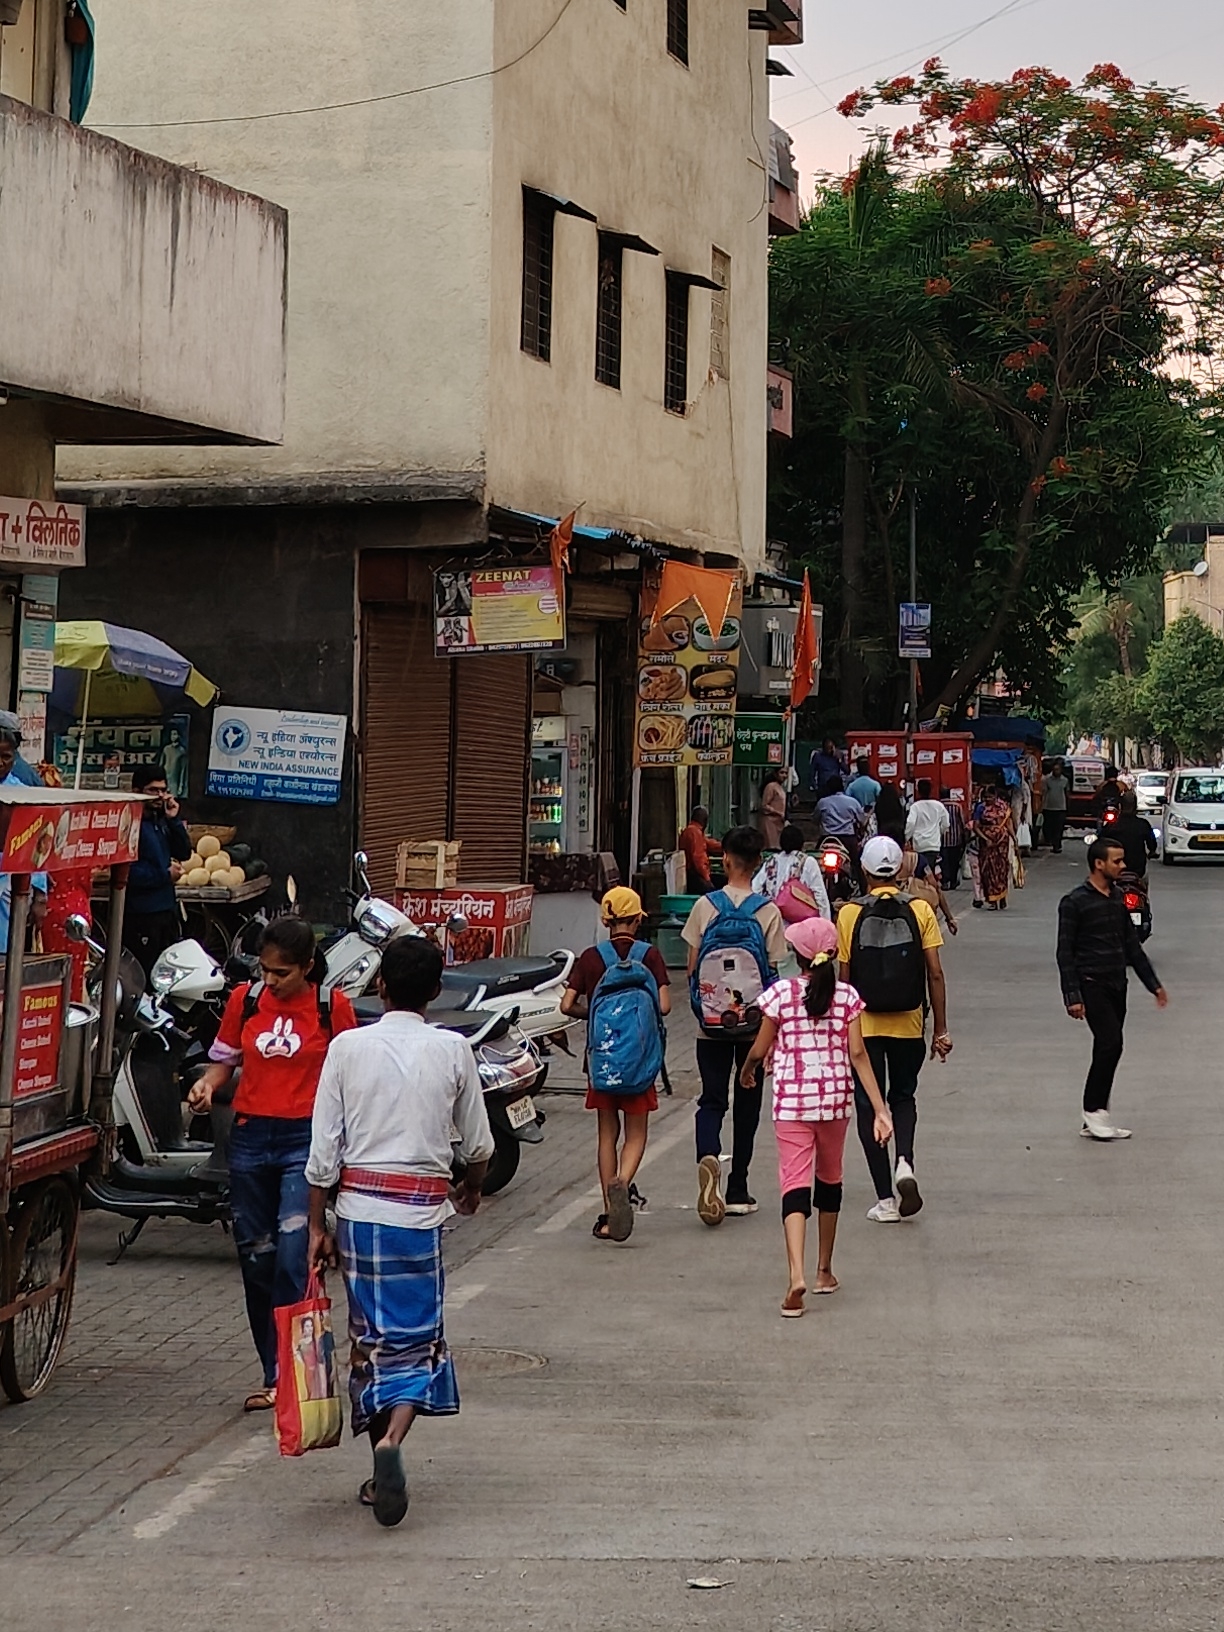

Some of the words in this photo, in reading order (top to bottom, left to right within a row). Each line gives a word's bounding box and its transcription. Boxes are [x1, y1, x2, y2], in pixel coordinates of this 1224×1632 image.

[26, 501, 80, 547] क्लिनिक
[476, 570, 531, 582] ZEENAT
[256, 731, 269, 743] न्यू
[271, 729, 297, 744] इंडिया
[253, 746, 266, 758] न्यू
[239, 760, 259, 769] NEW
[260, 761, 284, 772] INDIA
[285, 764, 339, 776] ASSURANCE
[9, 814, 44, 857] Famous
[24, 995, 57, 1011] Famous
